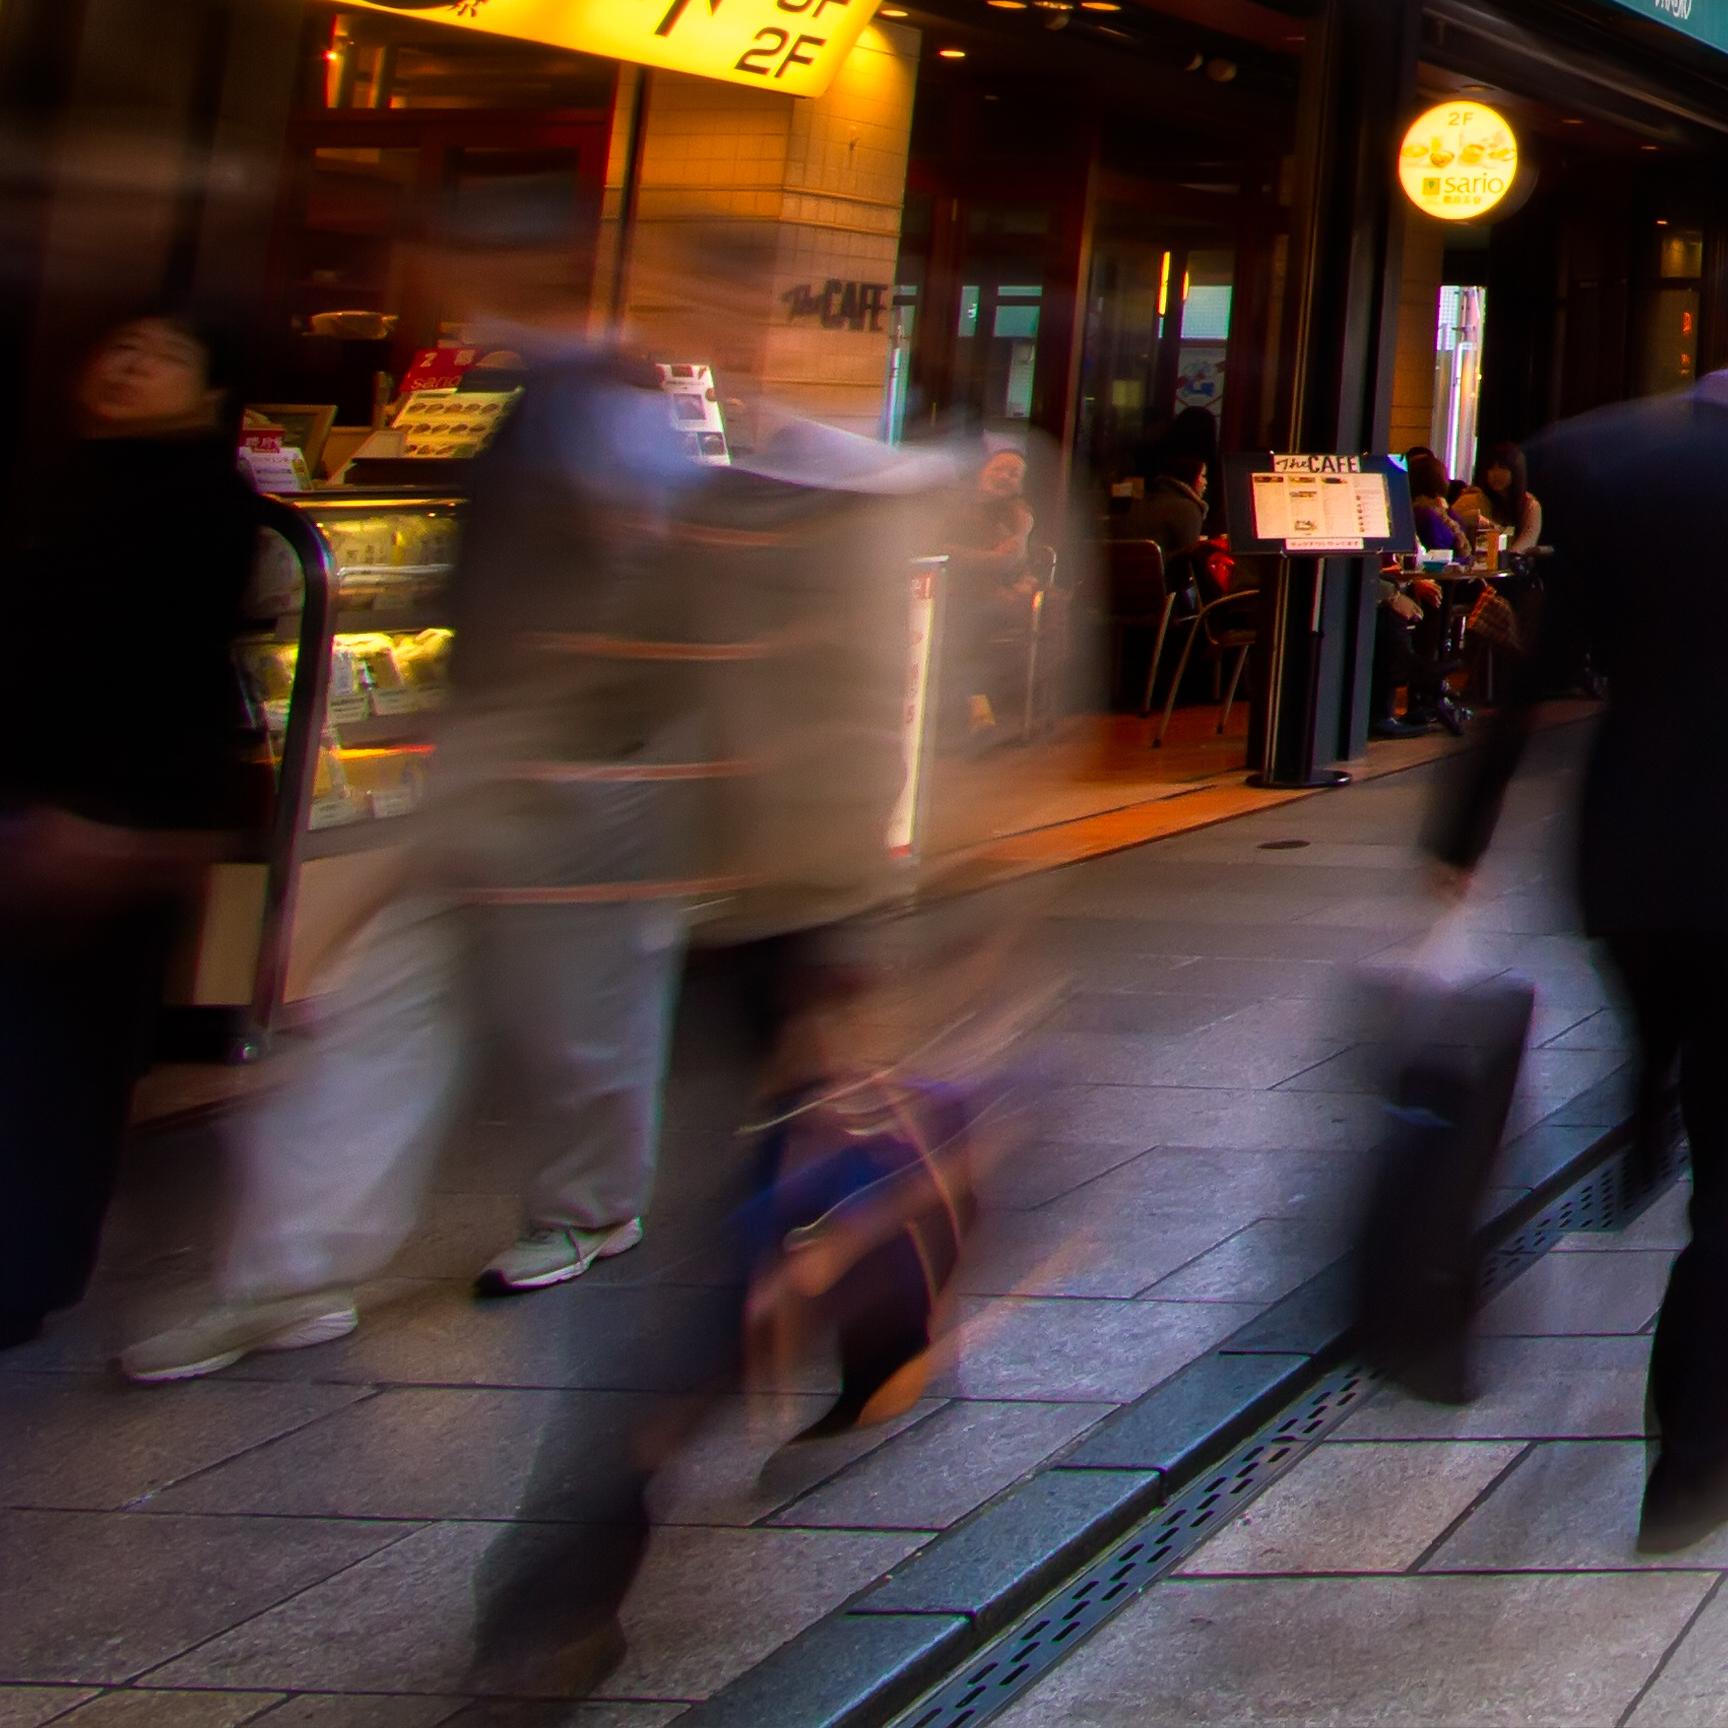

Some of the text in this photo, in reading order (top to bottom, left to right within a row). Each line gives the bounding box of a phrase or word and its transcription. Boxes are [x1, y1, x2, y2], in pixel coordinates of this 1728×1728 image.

[734, 26, 828, 79] 2F
[1448, 112, 1474, 126] 2F
[1444, 172, 1504, 193] sario
[1277, 455, 1359, 472] The CAFE
